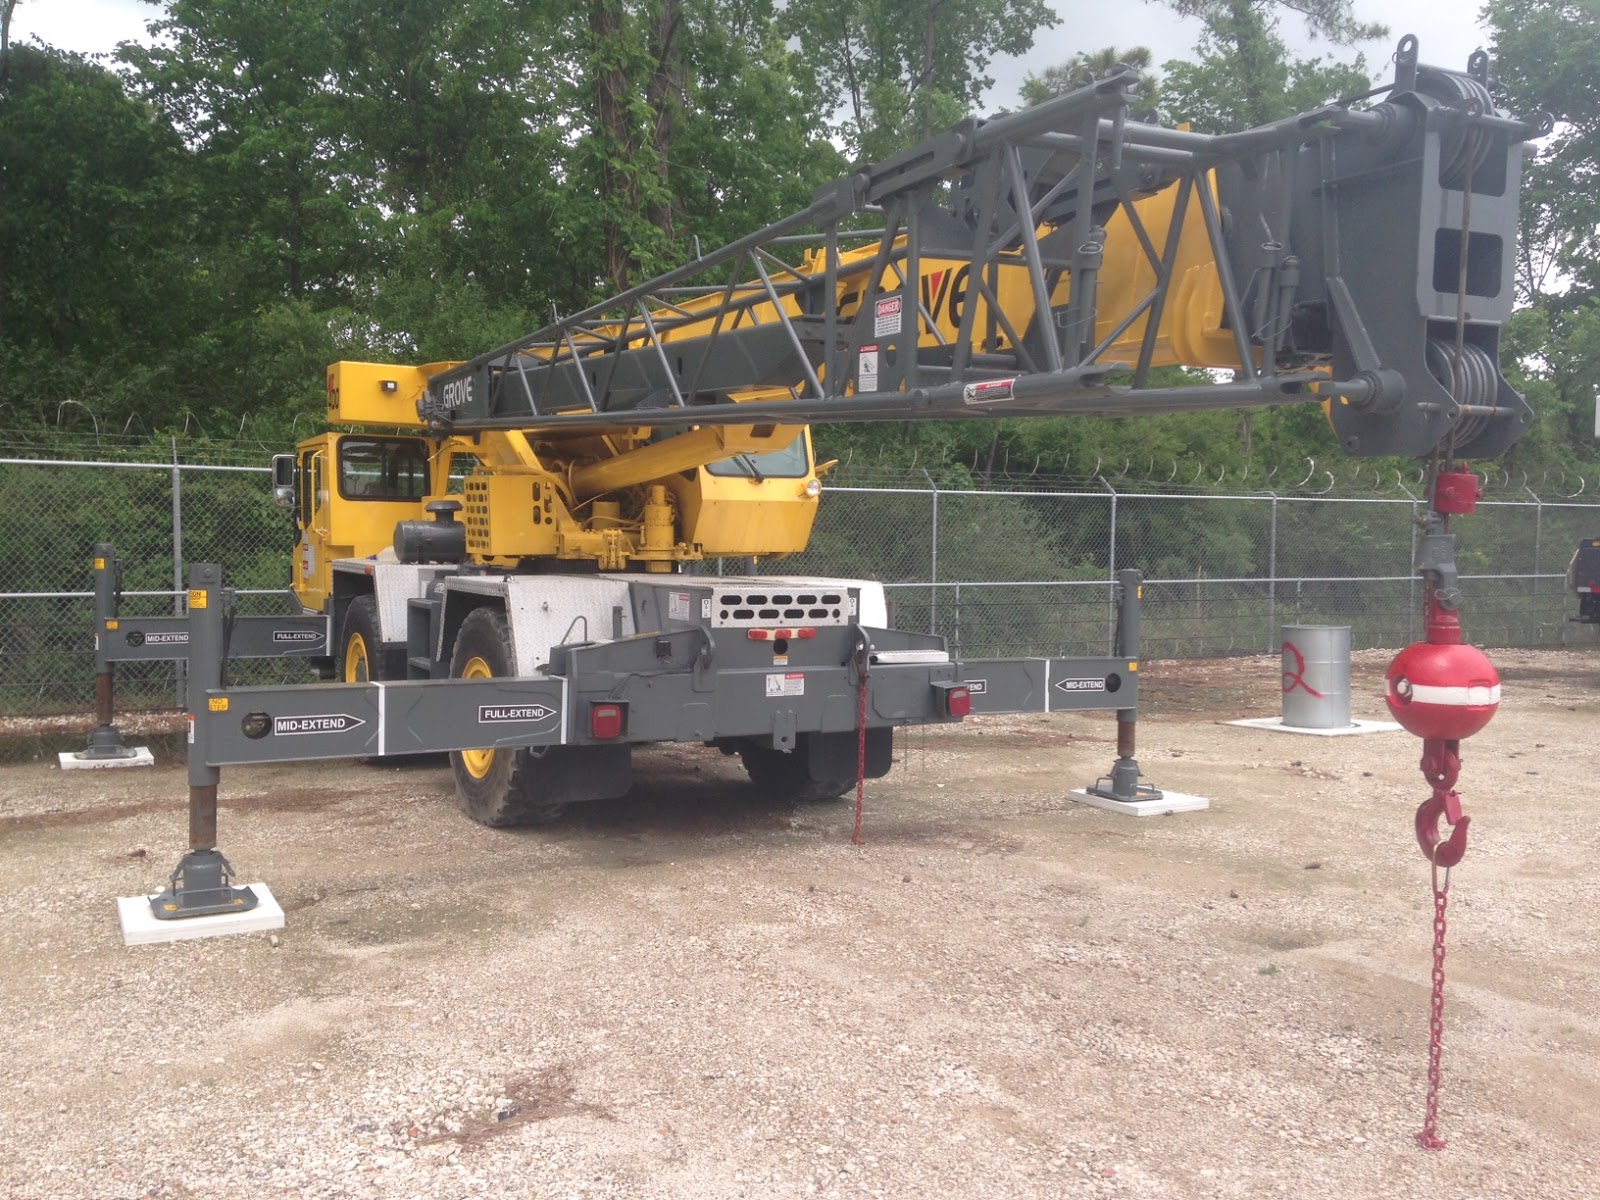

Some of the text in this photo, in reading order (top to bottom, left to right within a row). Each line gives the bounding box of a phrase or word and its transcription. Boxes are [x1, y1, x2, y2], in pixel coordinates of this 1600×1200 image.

[878, 301, 899, 314] DANGER
[443, 376, 472, 408] GROVE
[147, 634, 189, 642] MID-EXTEND
[1066, 681, 1103, 689] MID-EXTEND
[484, 708, 544, 719] FULL-EXTEND
[277, 718, 345, 731] MID-EXTEND
